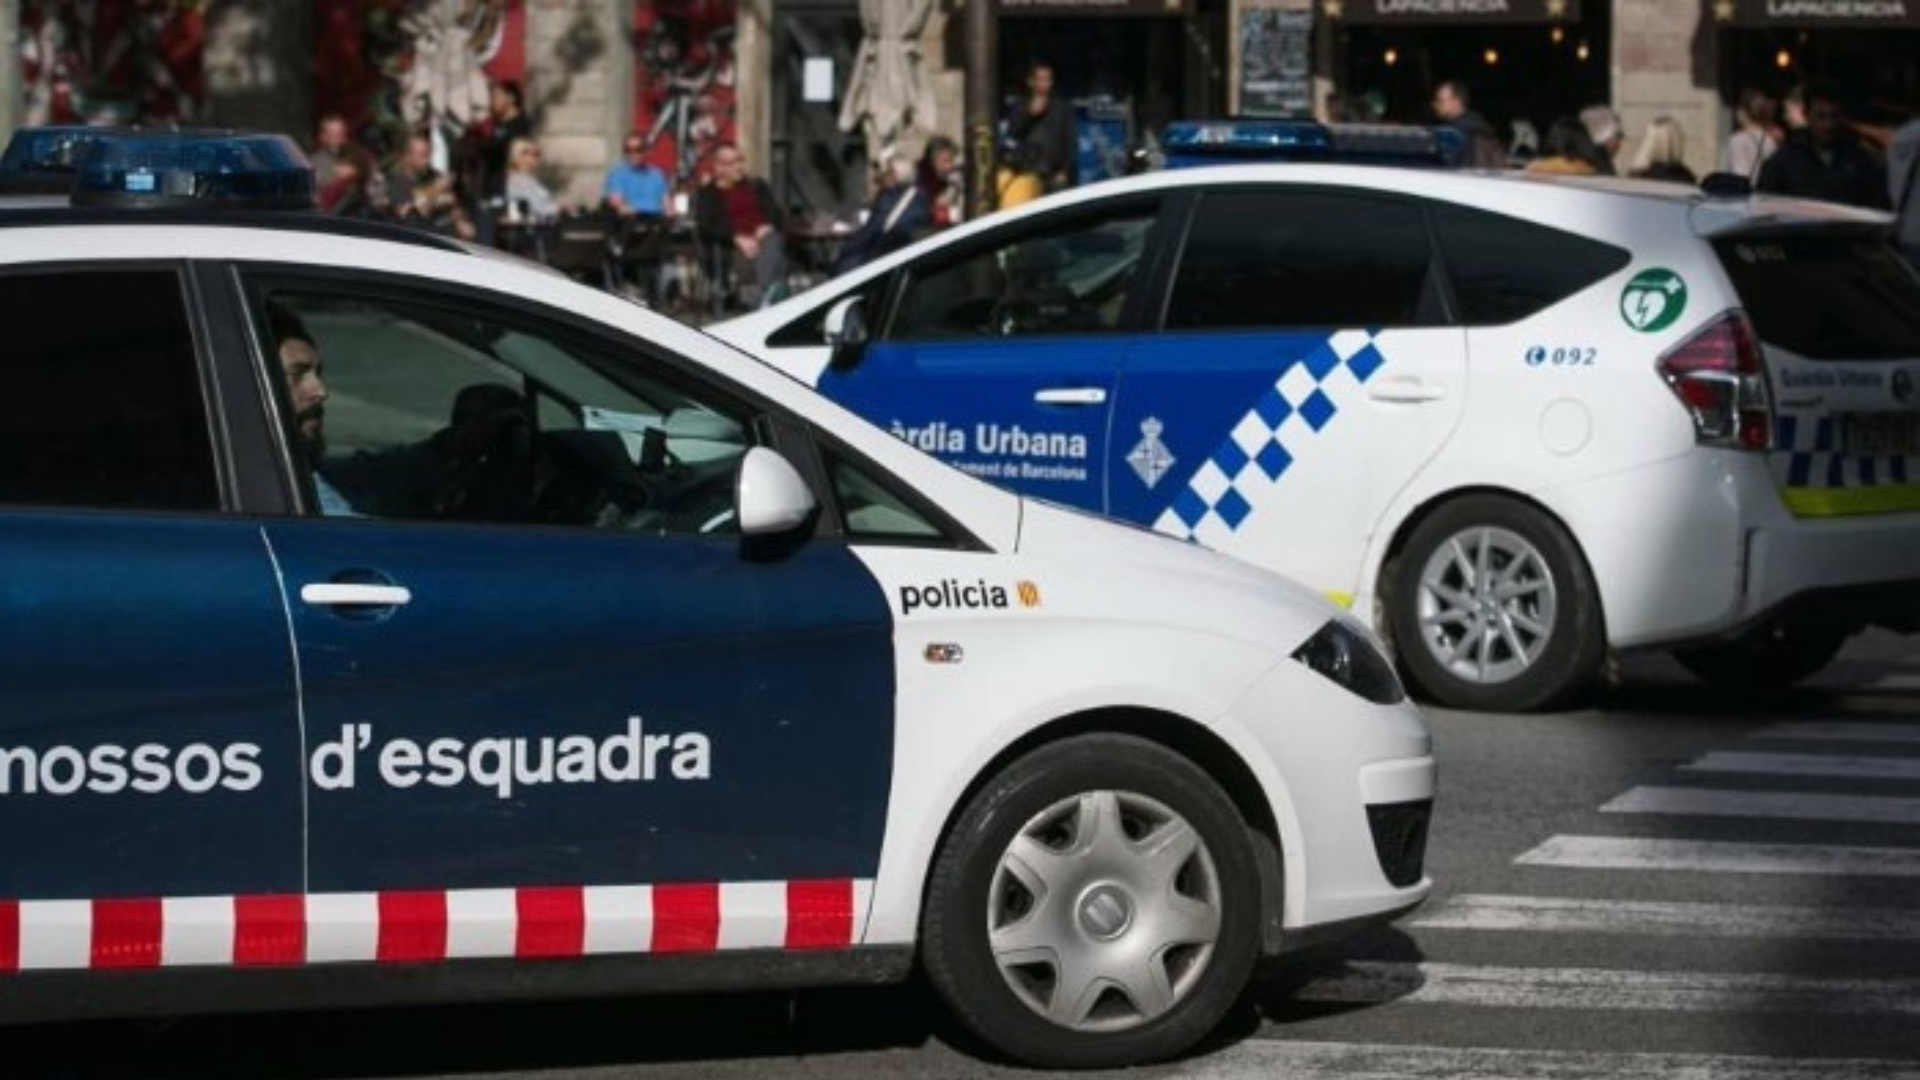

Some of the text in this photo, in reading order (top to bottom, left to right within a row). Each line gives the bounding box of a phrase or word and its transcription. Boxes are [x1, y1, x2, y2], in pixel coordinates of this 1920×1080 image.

[1552, 346, 1598, 366] 092
[890, 418, 1087, 458] àrdia Urbana
[1002, 462, 1019, 478] de
[1022, 462, 1087, 481] Barcelona
[900, 578, 1008, 615] policia
